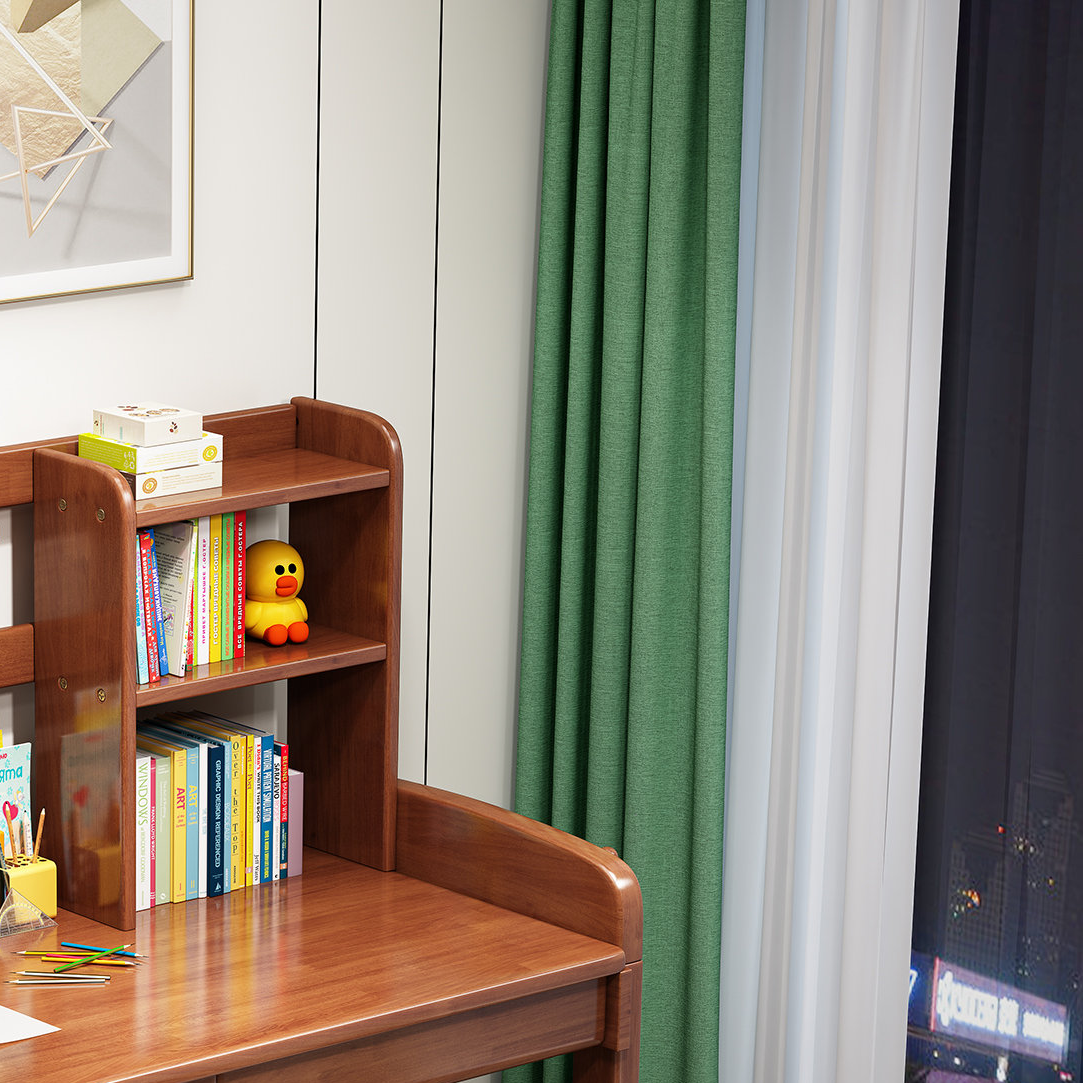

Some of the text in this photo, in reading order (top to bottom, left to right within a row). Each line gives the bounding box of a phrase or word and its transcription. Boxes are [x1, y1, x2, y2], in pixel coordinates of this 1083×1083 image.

[263, 749, 272, 771] VIRTUAL
[263, 772, 272, 792] PATIENT
[138, 762, 148, 826] WINDOWS
[177, 787, 185, 810] ART
[189, 785, 197, 808] ART
[263, 793, 272, 823] SIMULATION
